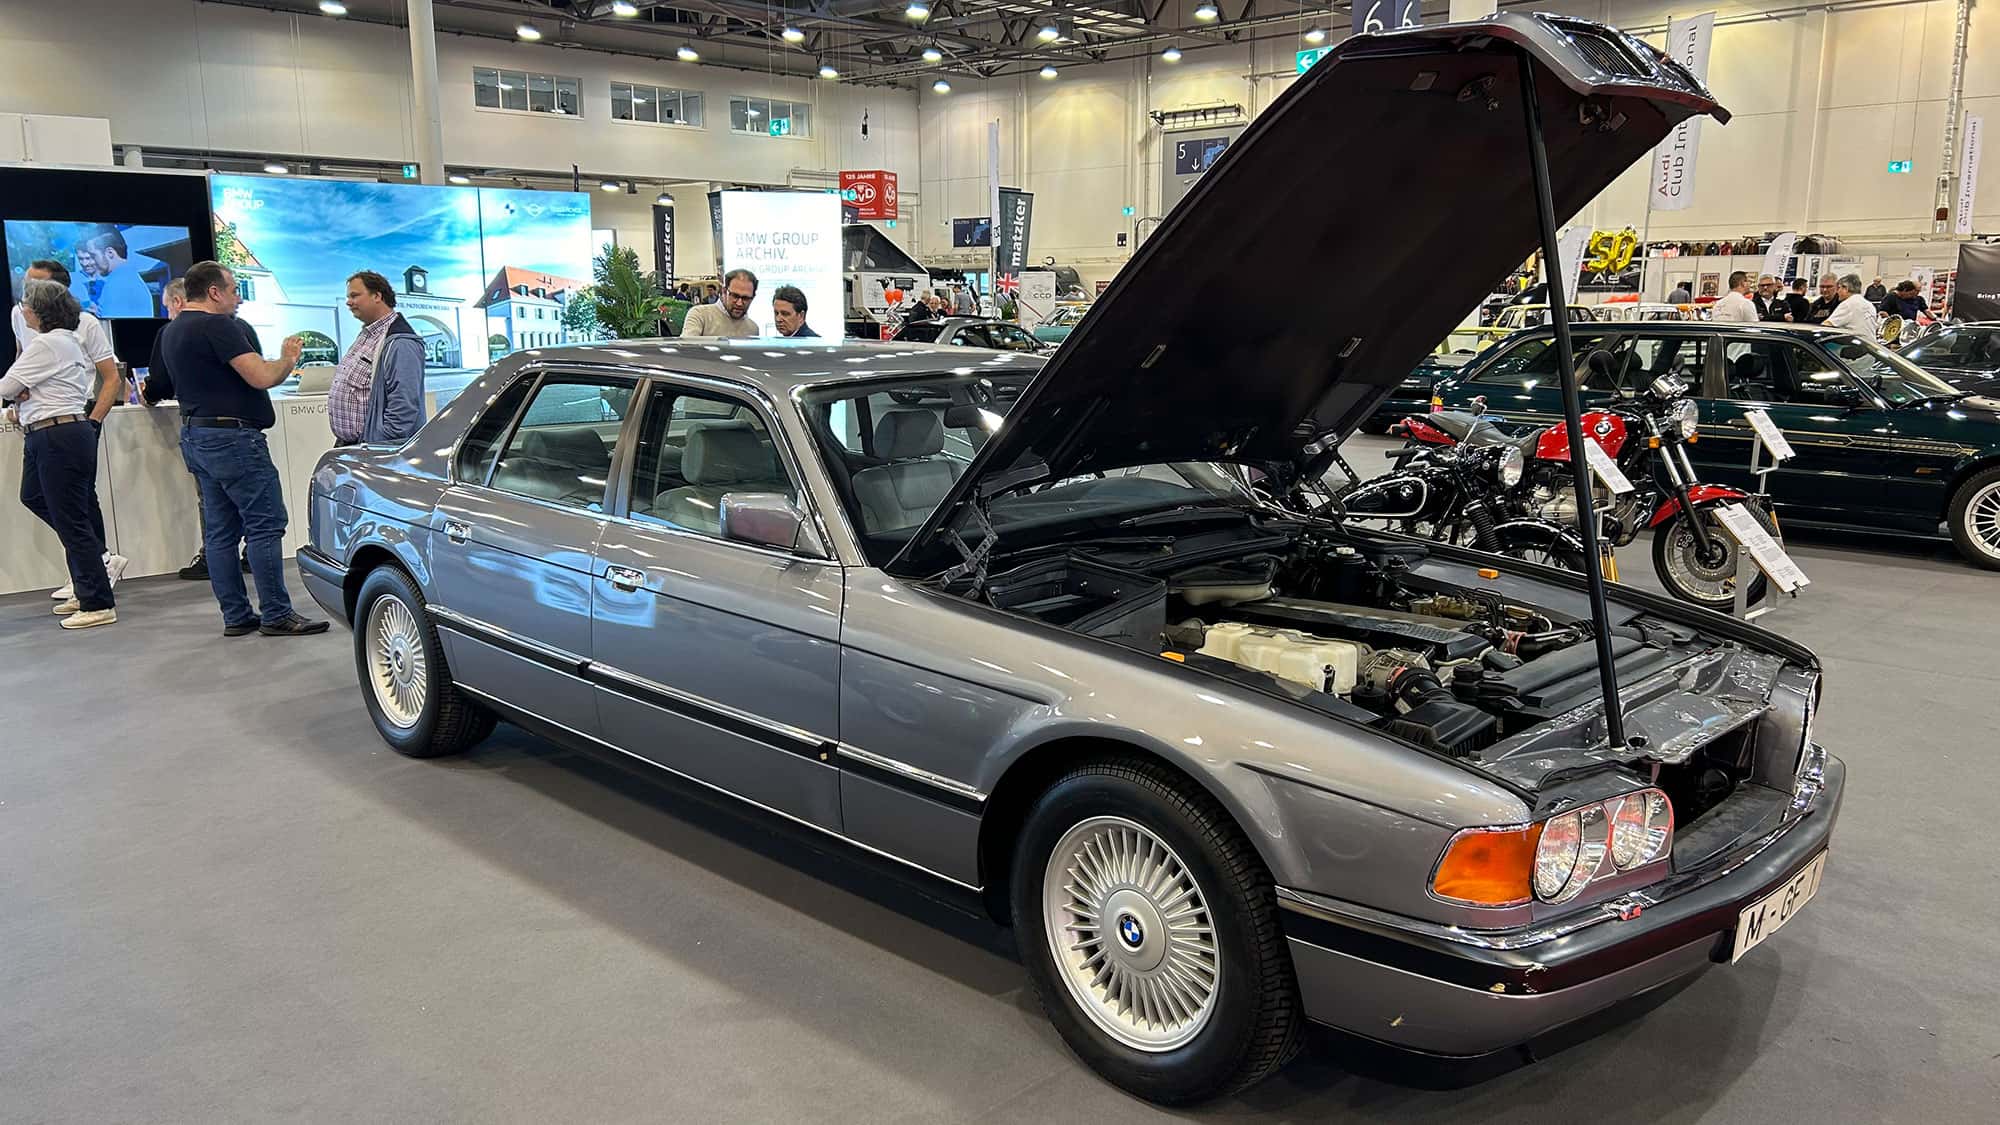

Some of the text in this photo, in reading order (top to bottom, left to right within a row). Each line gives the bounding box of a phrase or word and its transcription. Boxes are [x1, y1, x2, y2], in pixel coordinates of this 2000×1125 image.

[1178, 143, 1186, 159] 5
[1964, 121, 1977, 198] International
[1658, 154, 1671, 196] Audi
[1671, 156, 1684, 197] Club
[664, 213, 672, 290] matzker
[735, 232, 819, 245] BMW GROUP
[735, 247, 788, 260] ARCHIV.
[1011, 198, 1027, 267] matzker
[1589, 230, 1638, 273] 50
[291, 406, 315, 415] BMW
[1744, 904, 1767, 948] M
[1781, 875, 1805, 921] GF
